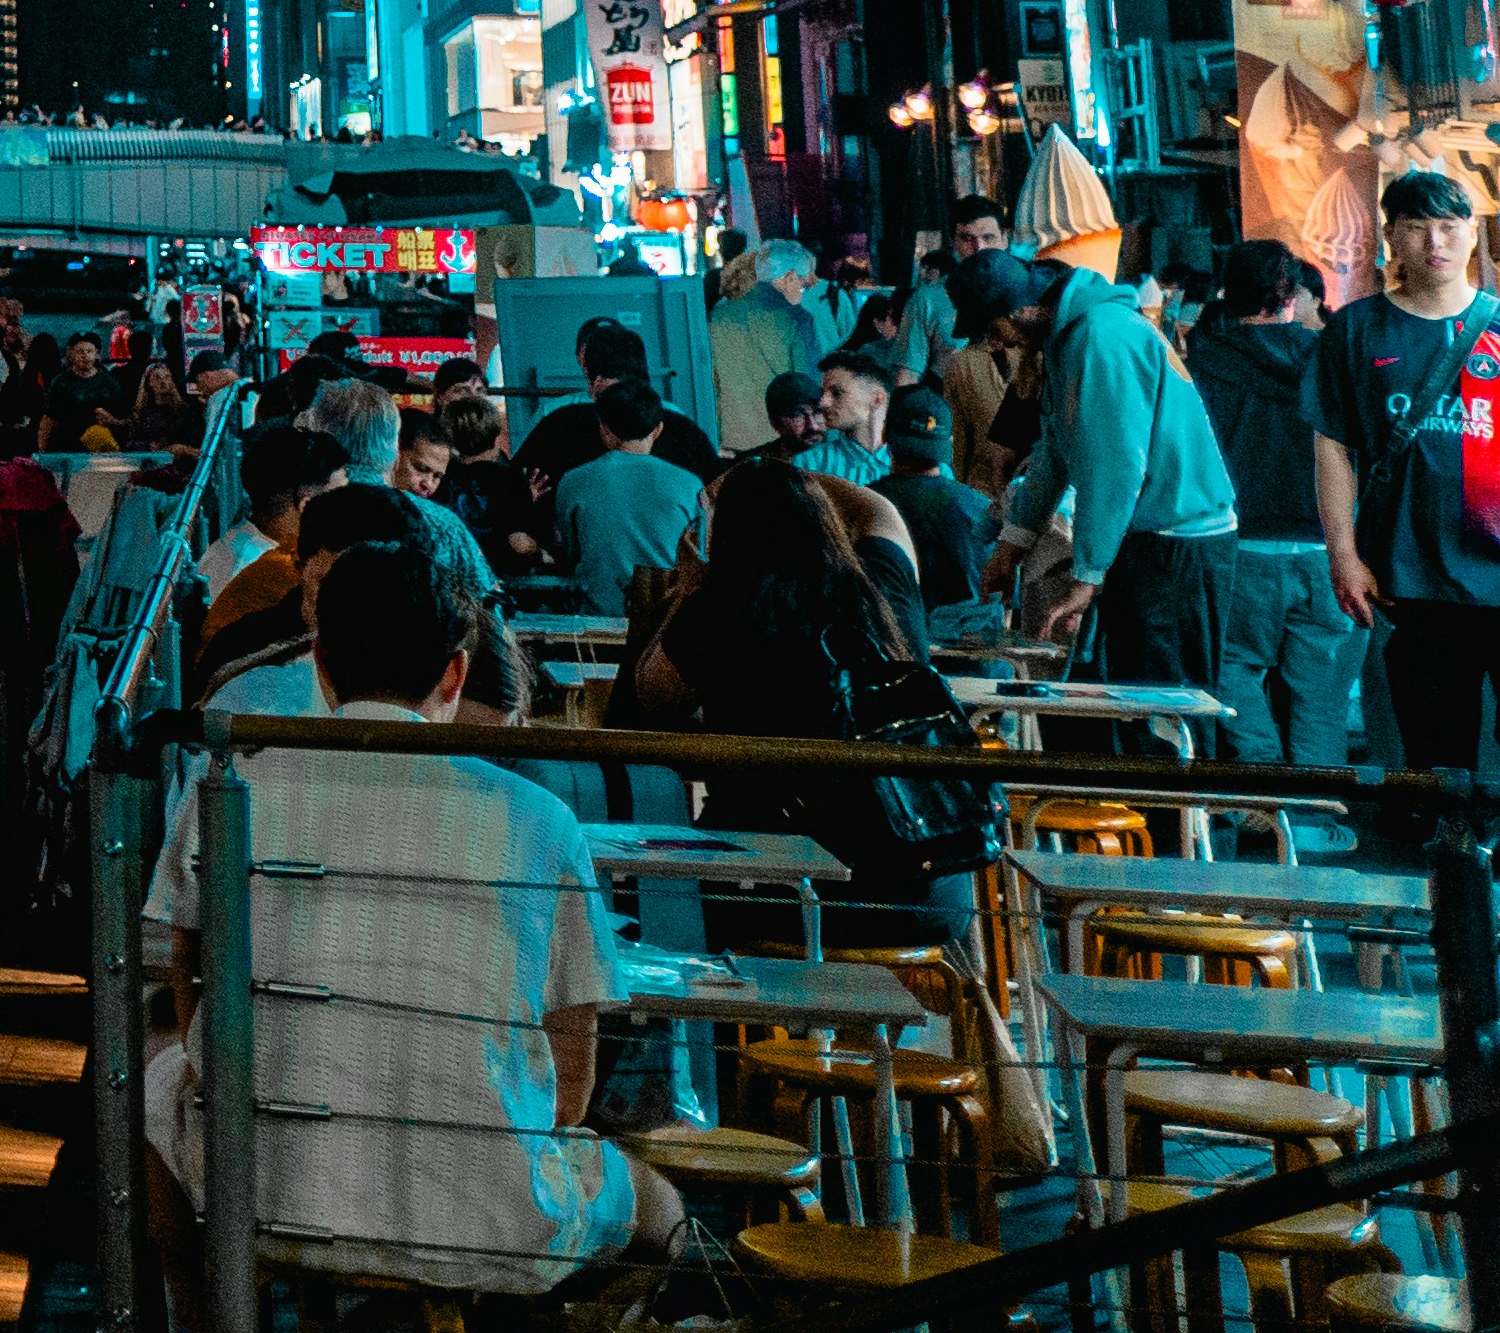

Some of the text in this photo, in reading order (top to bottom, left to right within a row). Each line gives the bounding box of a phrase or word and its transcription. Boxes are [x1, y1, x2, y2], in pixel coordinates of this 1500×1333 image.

[610, 81, 651, 103] ZUN
[254, 241, 391, 268] TICKET
[1387, 392, 1494, 422] QTAR
